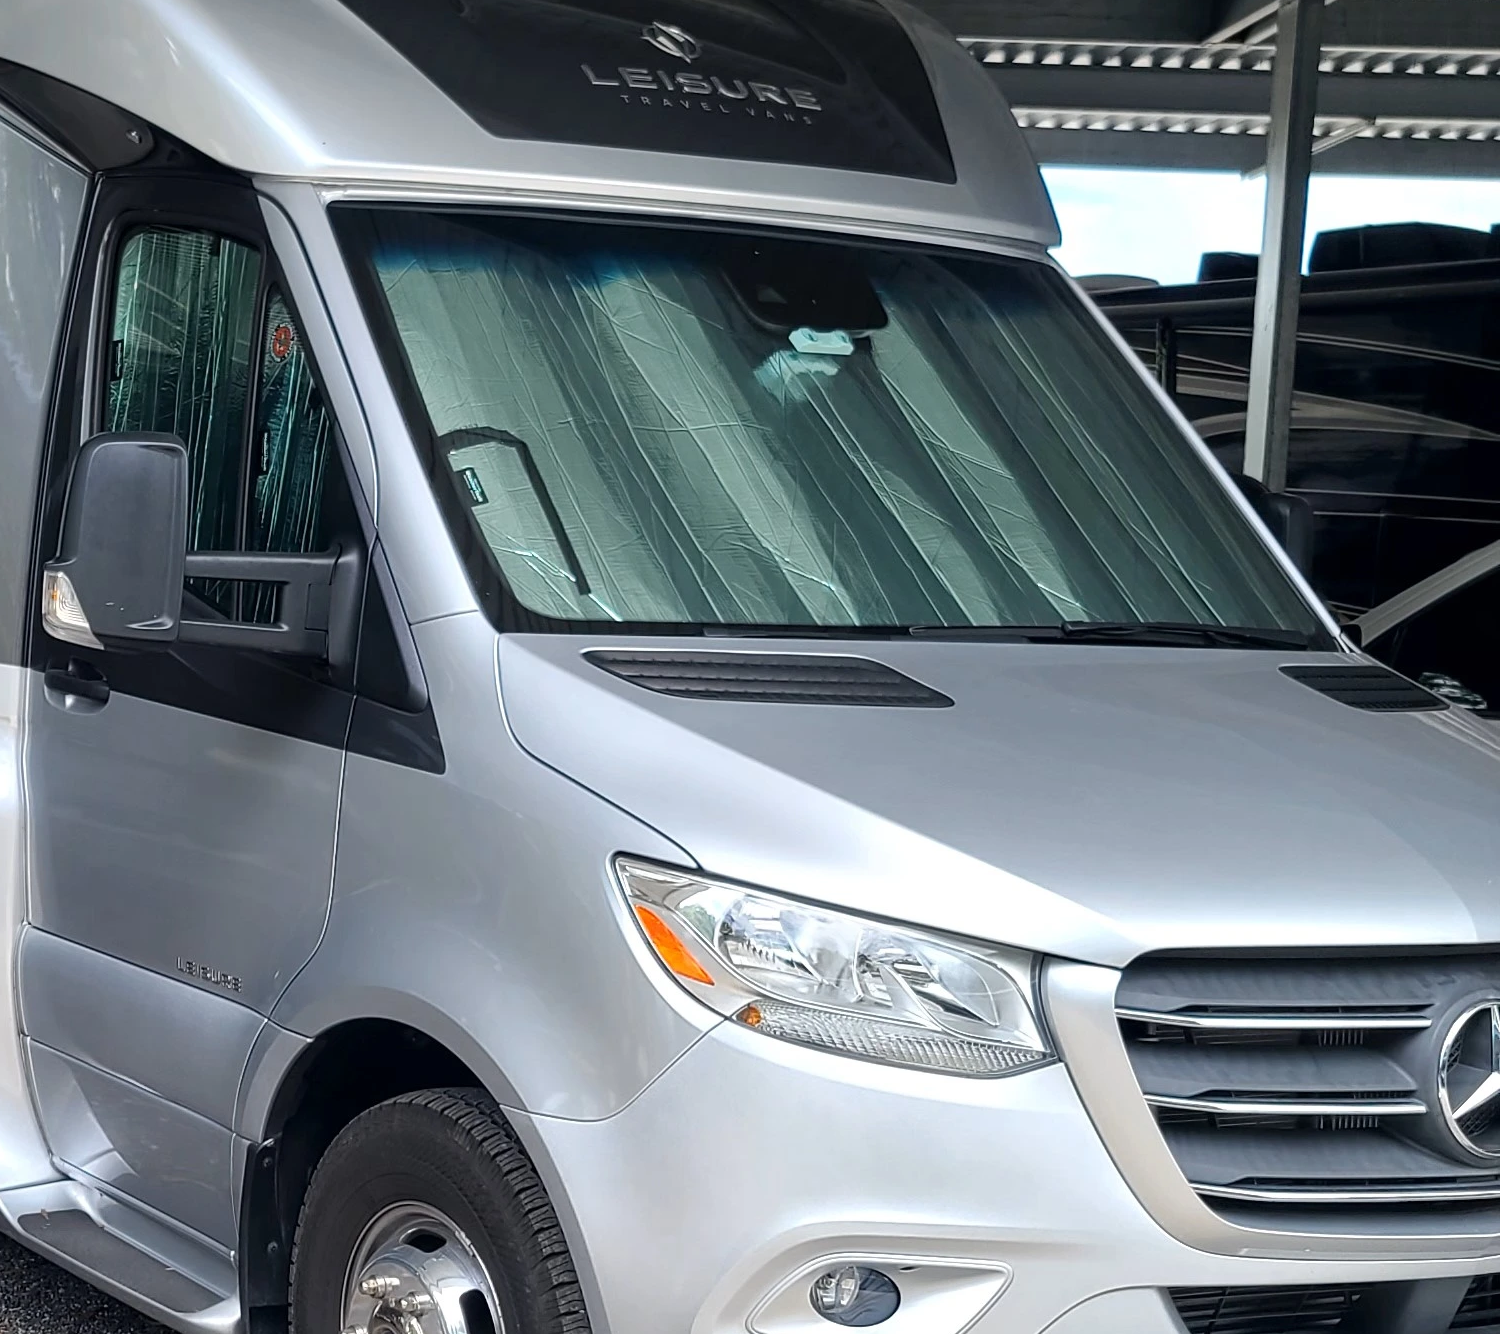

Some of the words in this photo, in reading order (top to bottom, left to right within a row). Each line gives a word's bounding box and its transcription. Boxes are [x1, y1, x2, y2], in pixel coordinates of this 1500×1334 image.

[580, 62, 823, 112] LEISURE
[619, 94, 730, 114] TRAVEL
[745, 107, 813, 126] VANS
[175, 955, 242, 993] LEISURE
